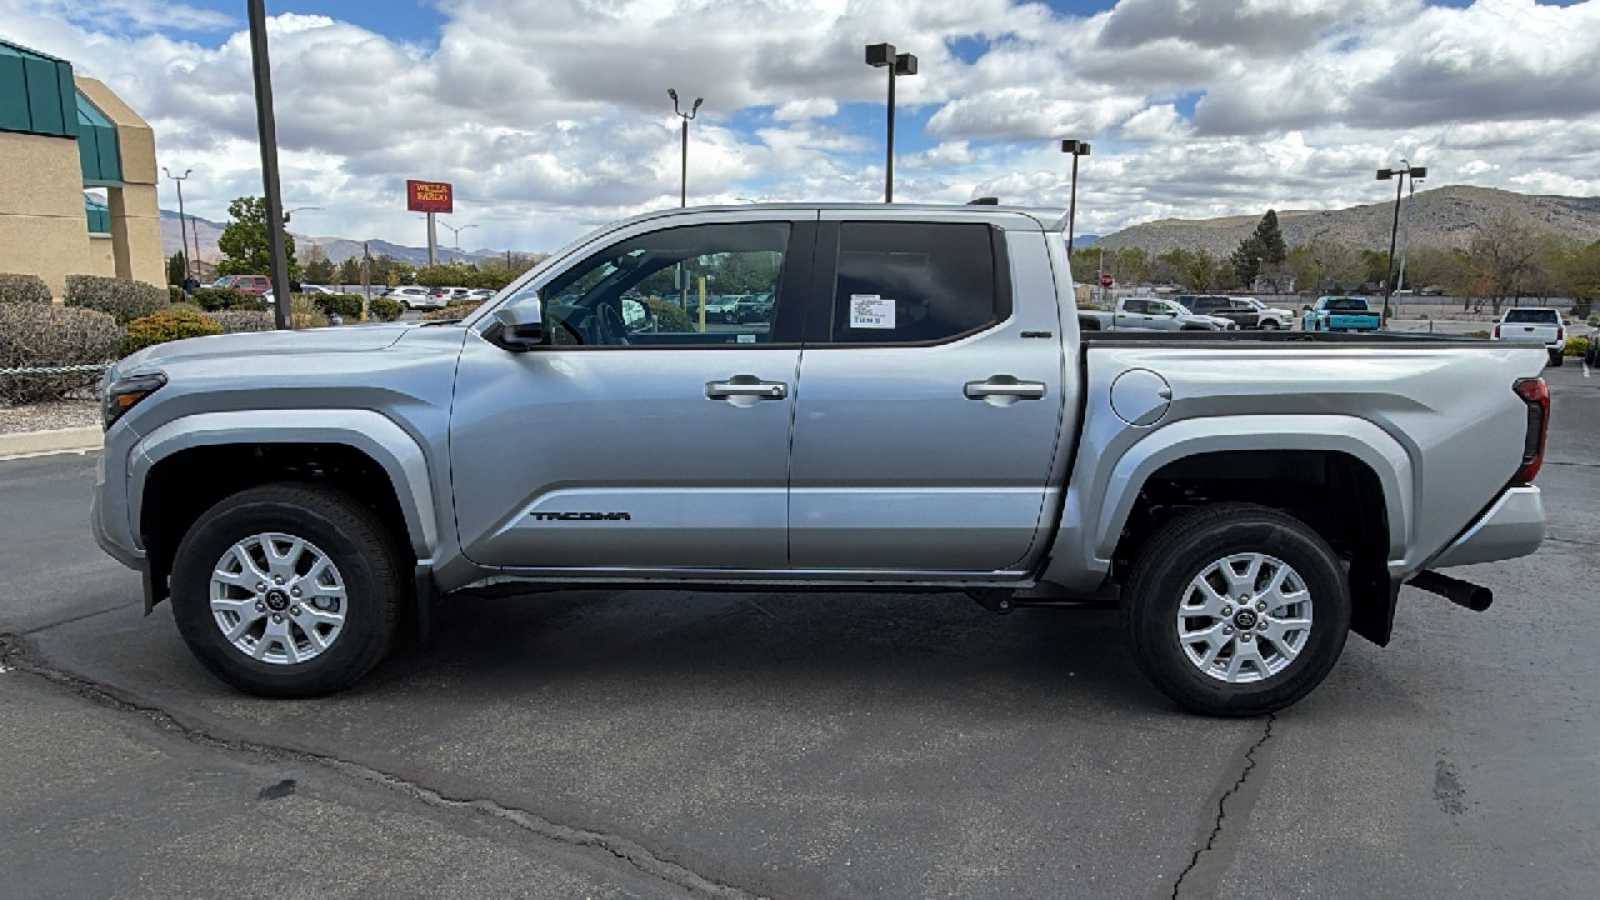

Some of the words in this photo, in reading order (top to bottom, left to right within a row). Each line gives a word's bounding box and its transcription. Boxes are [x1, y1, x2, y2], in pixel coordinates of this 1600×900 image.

[415, 183, 447, 193] WELLS
[416, 191, 447, 201] FARGO
[530, 512, 631, 521] TACOMA
